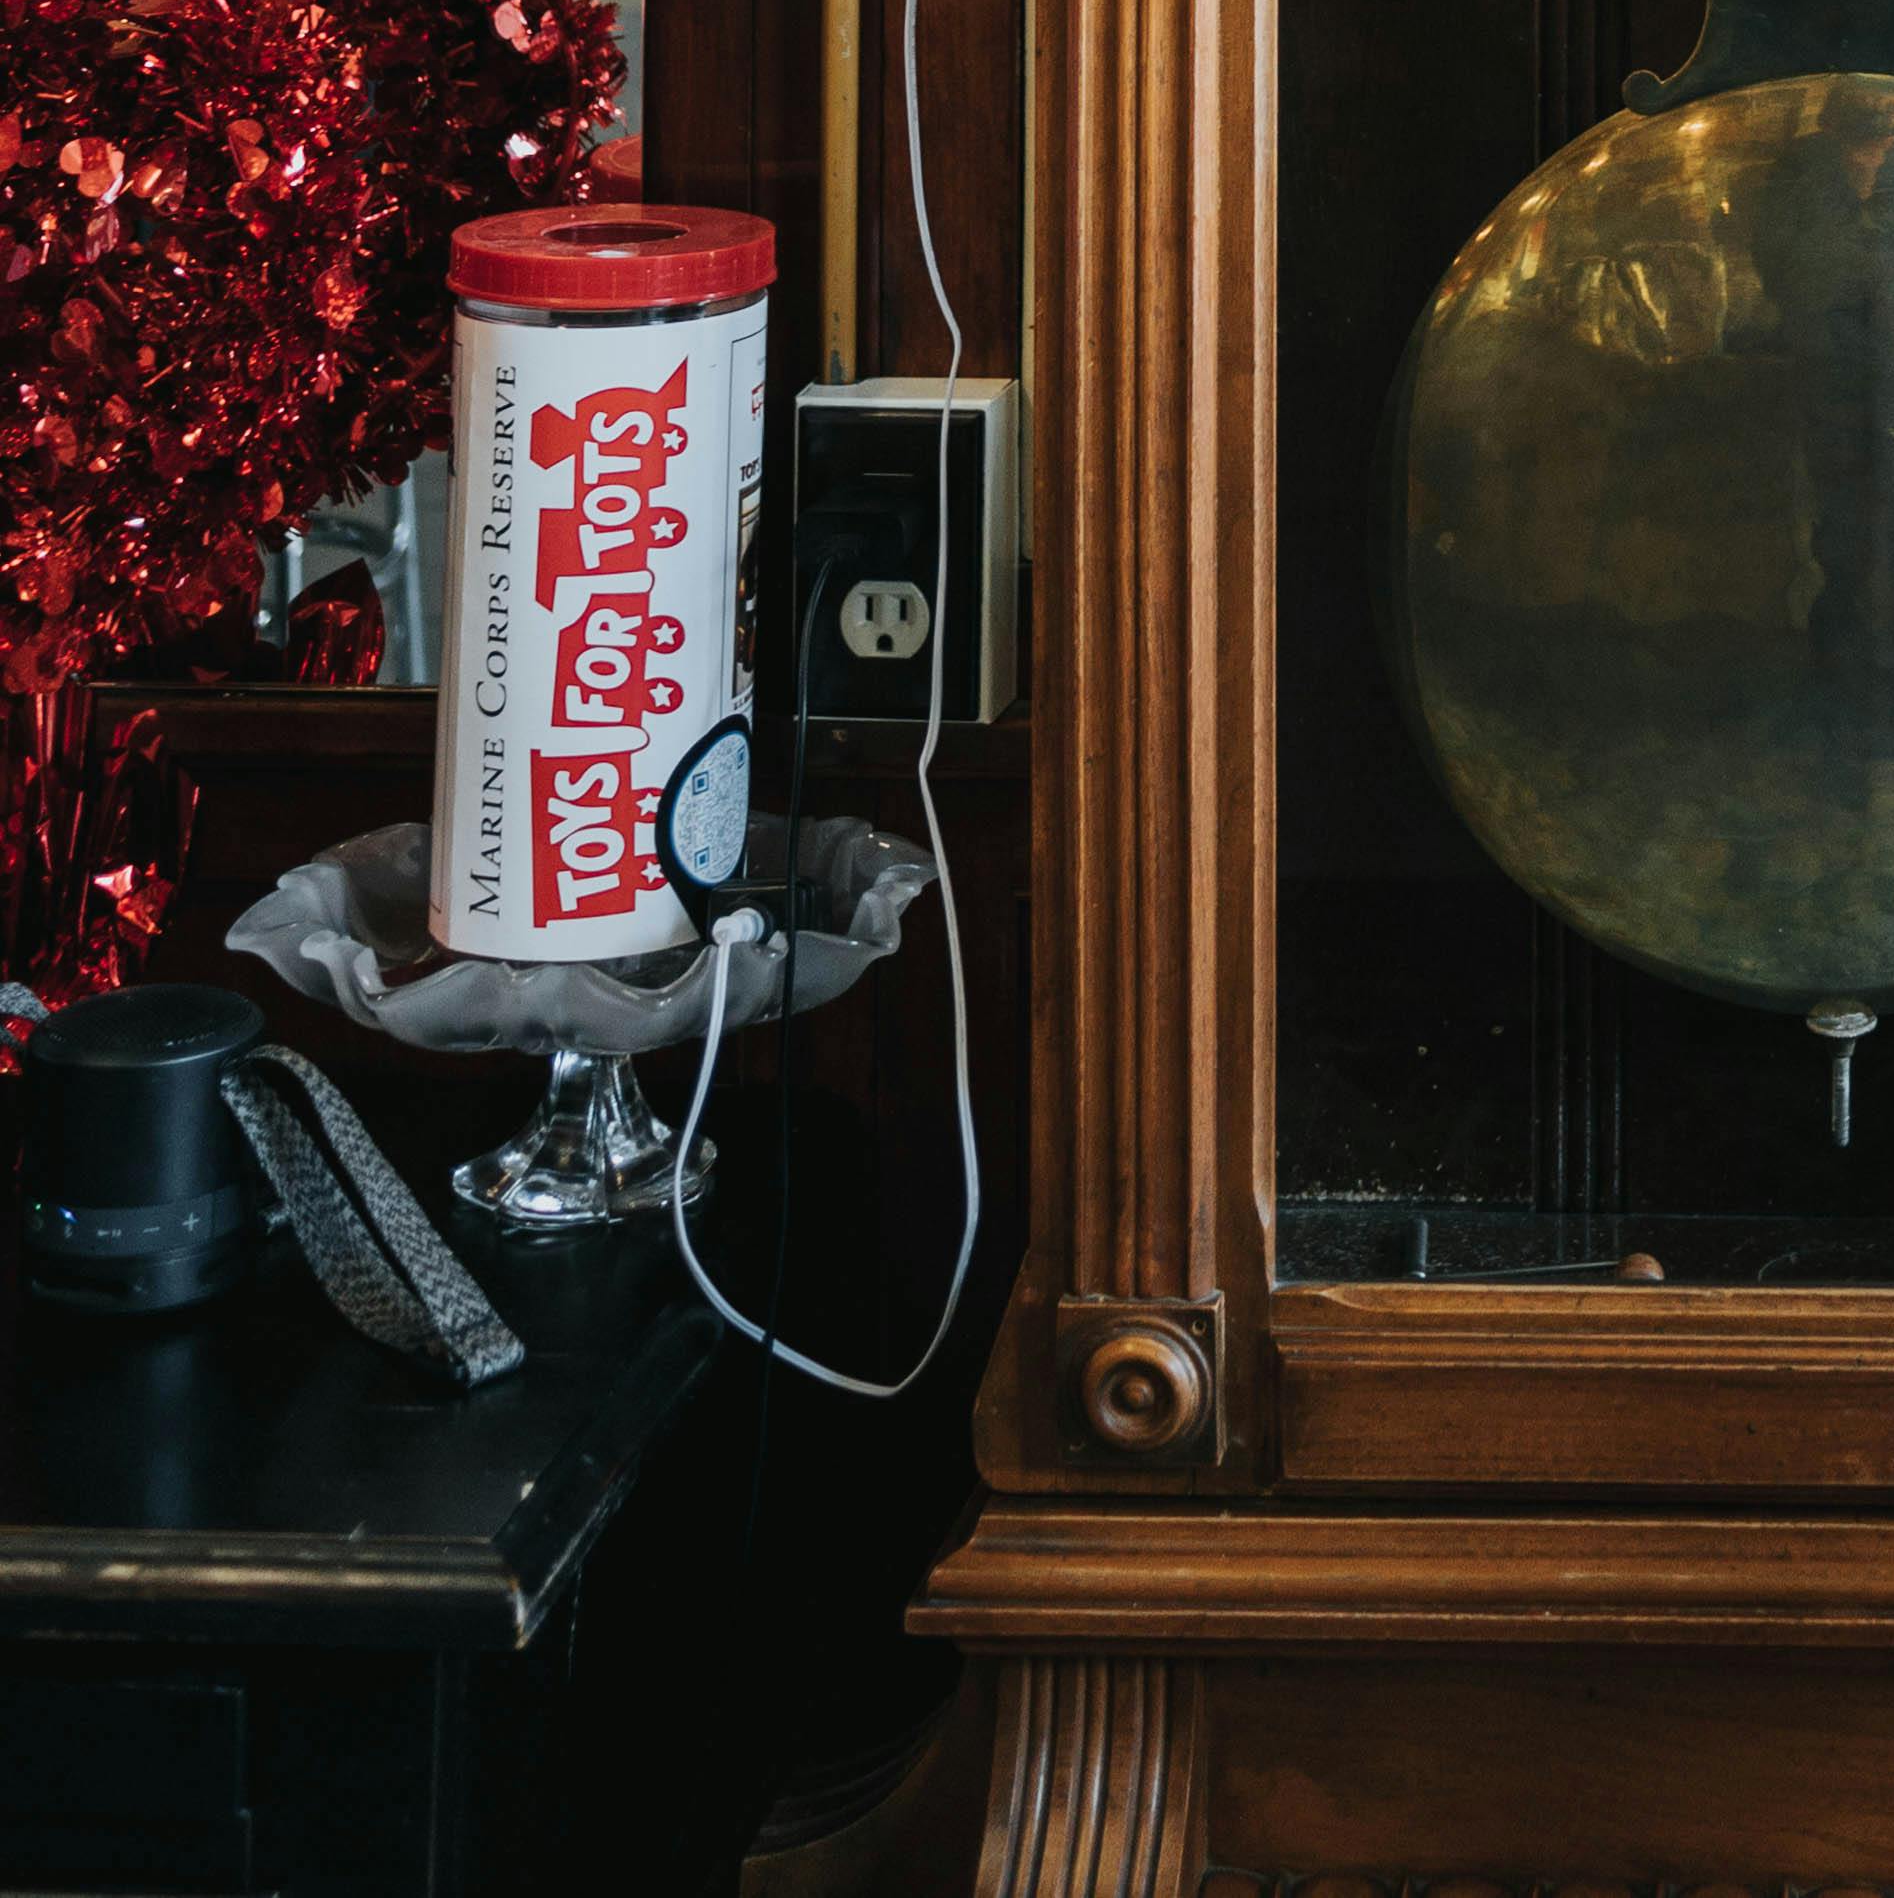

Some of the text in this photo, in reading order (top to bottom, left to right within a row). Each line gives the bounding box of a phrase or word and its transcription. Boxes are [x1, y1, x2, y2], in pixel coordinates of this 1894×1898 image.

[468, 364, 517, 918] MARINE CORPS RESERVE
[547, 410, 656, 913] TOYS FOR TOTS
